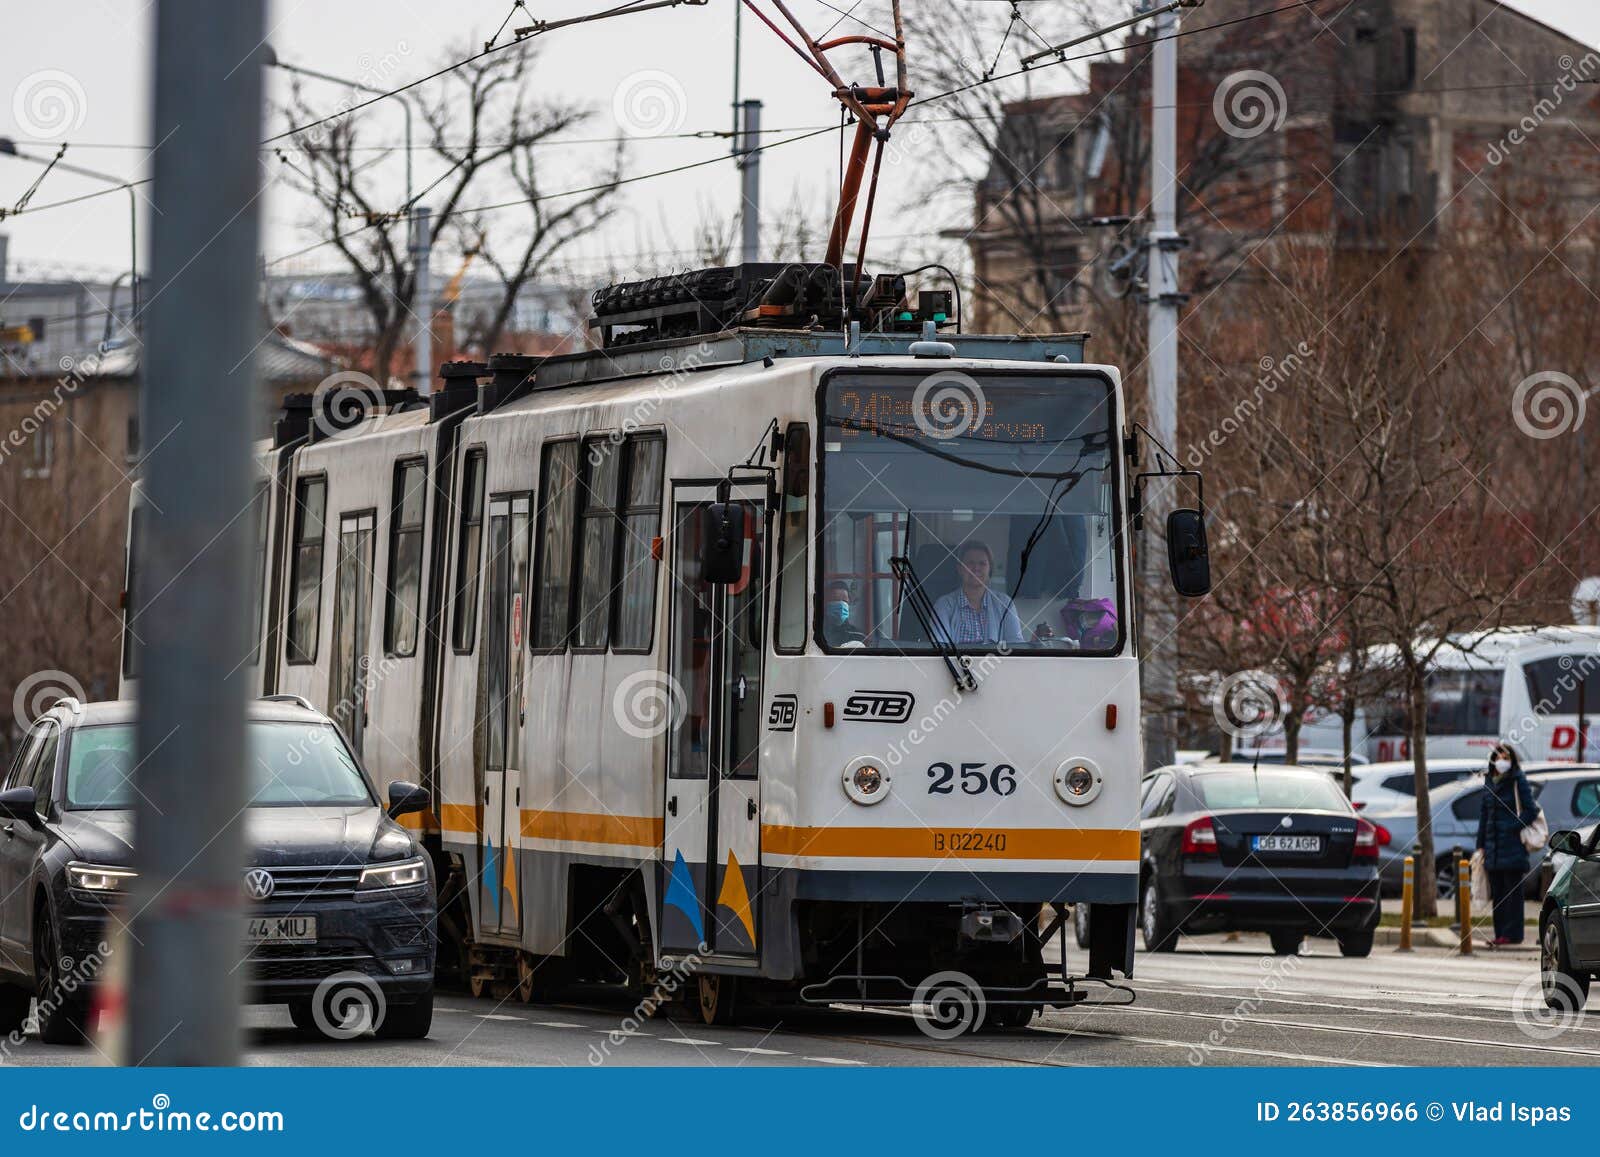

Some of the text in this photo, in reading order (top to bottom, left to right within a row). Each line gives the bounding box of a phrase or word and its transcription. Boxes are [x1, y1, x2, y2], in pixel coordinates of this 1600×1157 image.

[840, 391, 878, 437] 24
[769, 701, 795, 724] STB
[843, 696, 908, 717] STB
[927, 762, 1016, 796] 256
[934, 832, 1006, 851] B 02240
[1279, 837, 1293, 850] 62
[248, 919, 307, 937] 44 MIU
